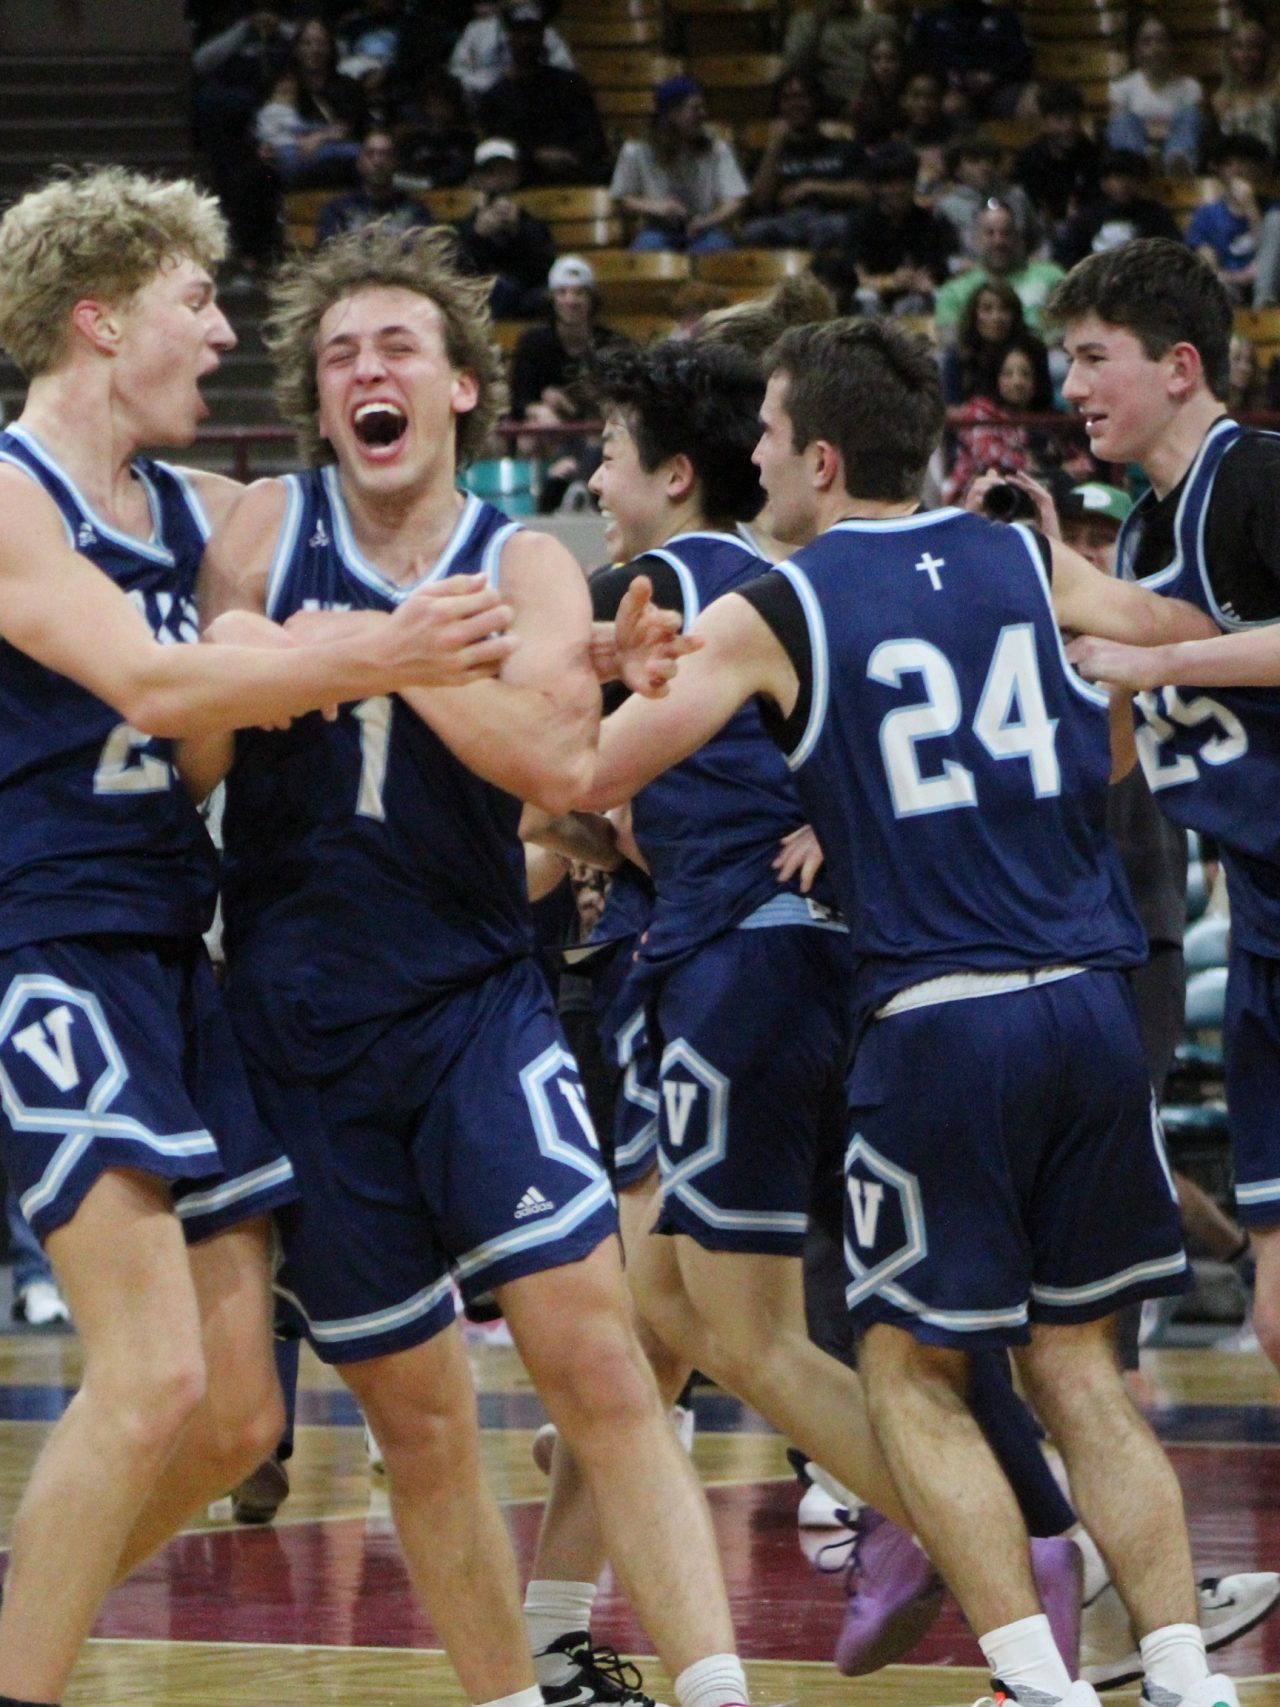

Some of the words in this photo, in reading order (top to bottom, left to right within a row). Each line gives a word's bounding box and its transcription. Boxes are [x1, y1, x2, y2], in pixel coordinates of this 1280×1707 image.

[351, 697, 386, 822] 1
[866, 622, 1062, 819] 24
[12, 1005, 76, 1093] V
[662, 1079, 698, 1147] V
[513, 1200, 555, 1219] adidas
[847, 1176, 883, 1249] V
